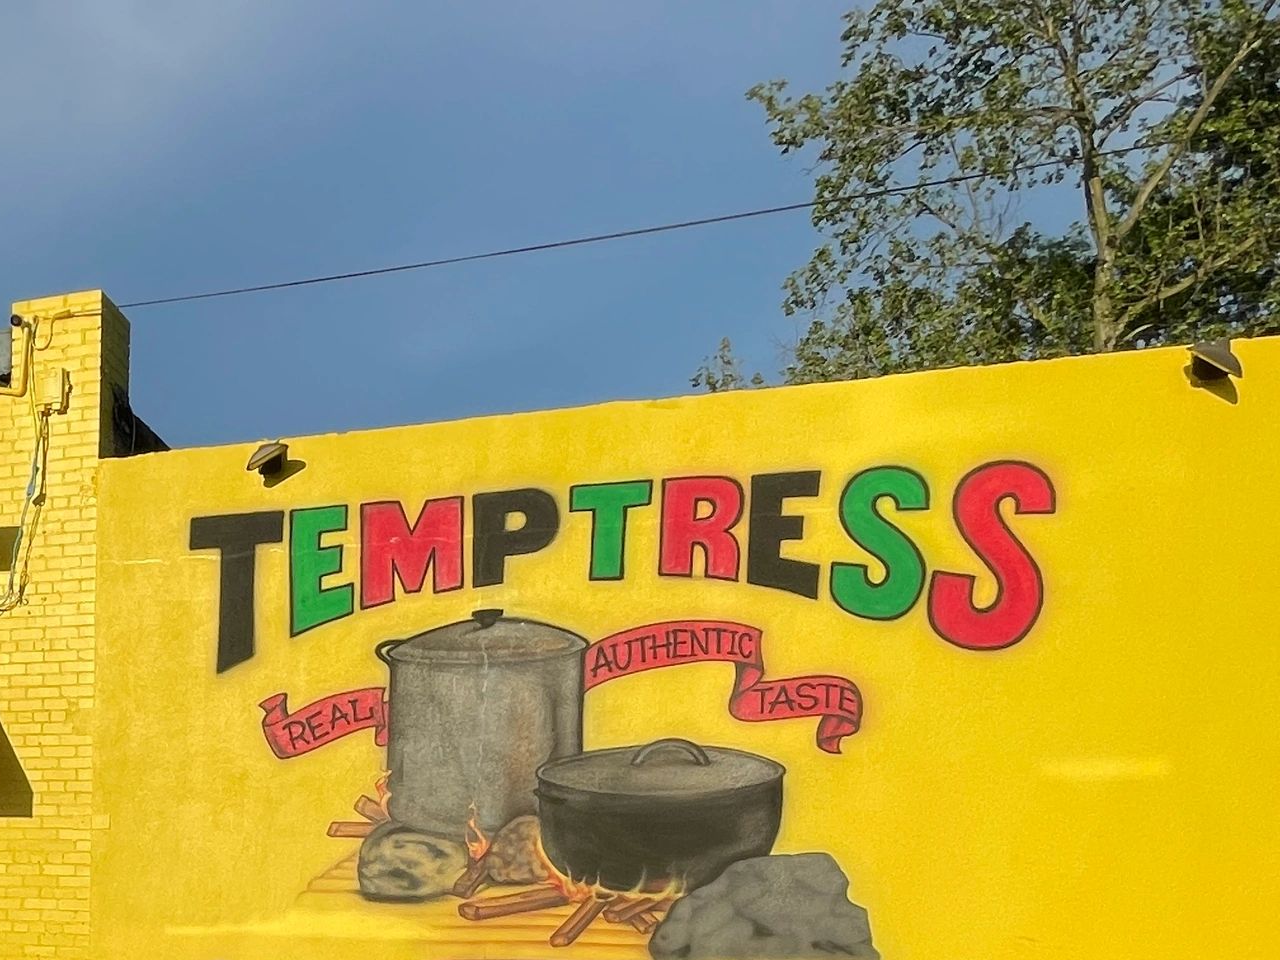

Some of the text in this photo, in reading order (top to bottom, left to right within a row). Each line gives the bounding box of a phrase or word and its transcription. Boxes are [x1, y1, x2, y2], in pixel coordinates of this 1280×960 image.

[188, 459, 1057, 674] TEMPTRESS
[282, 628, 858, 750] REAL AUTHENTIC TASTE
